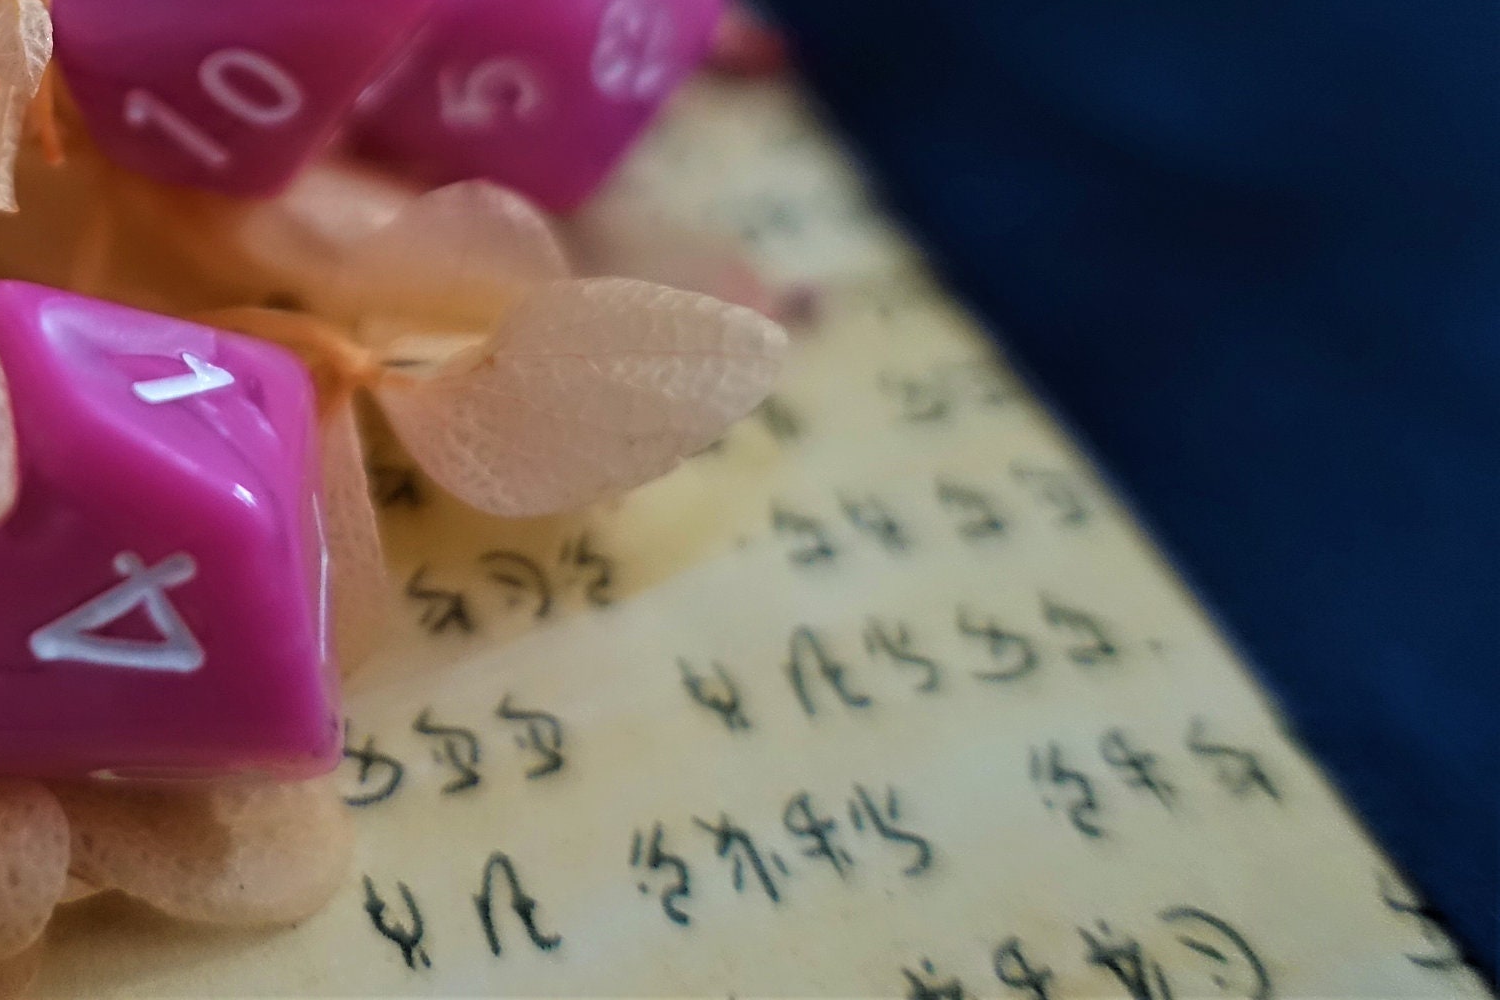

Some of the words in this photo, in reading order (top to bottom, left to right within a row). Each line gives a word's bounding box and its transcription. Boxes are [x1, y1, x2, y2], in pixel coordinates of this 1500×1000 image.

[124, 47, 302, 169] 10
[131, 349, 236, 404] 1
[28, 551, 206, 674] 4
